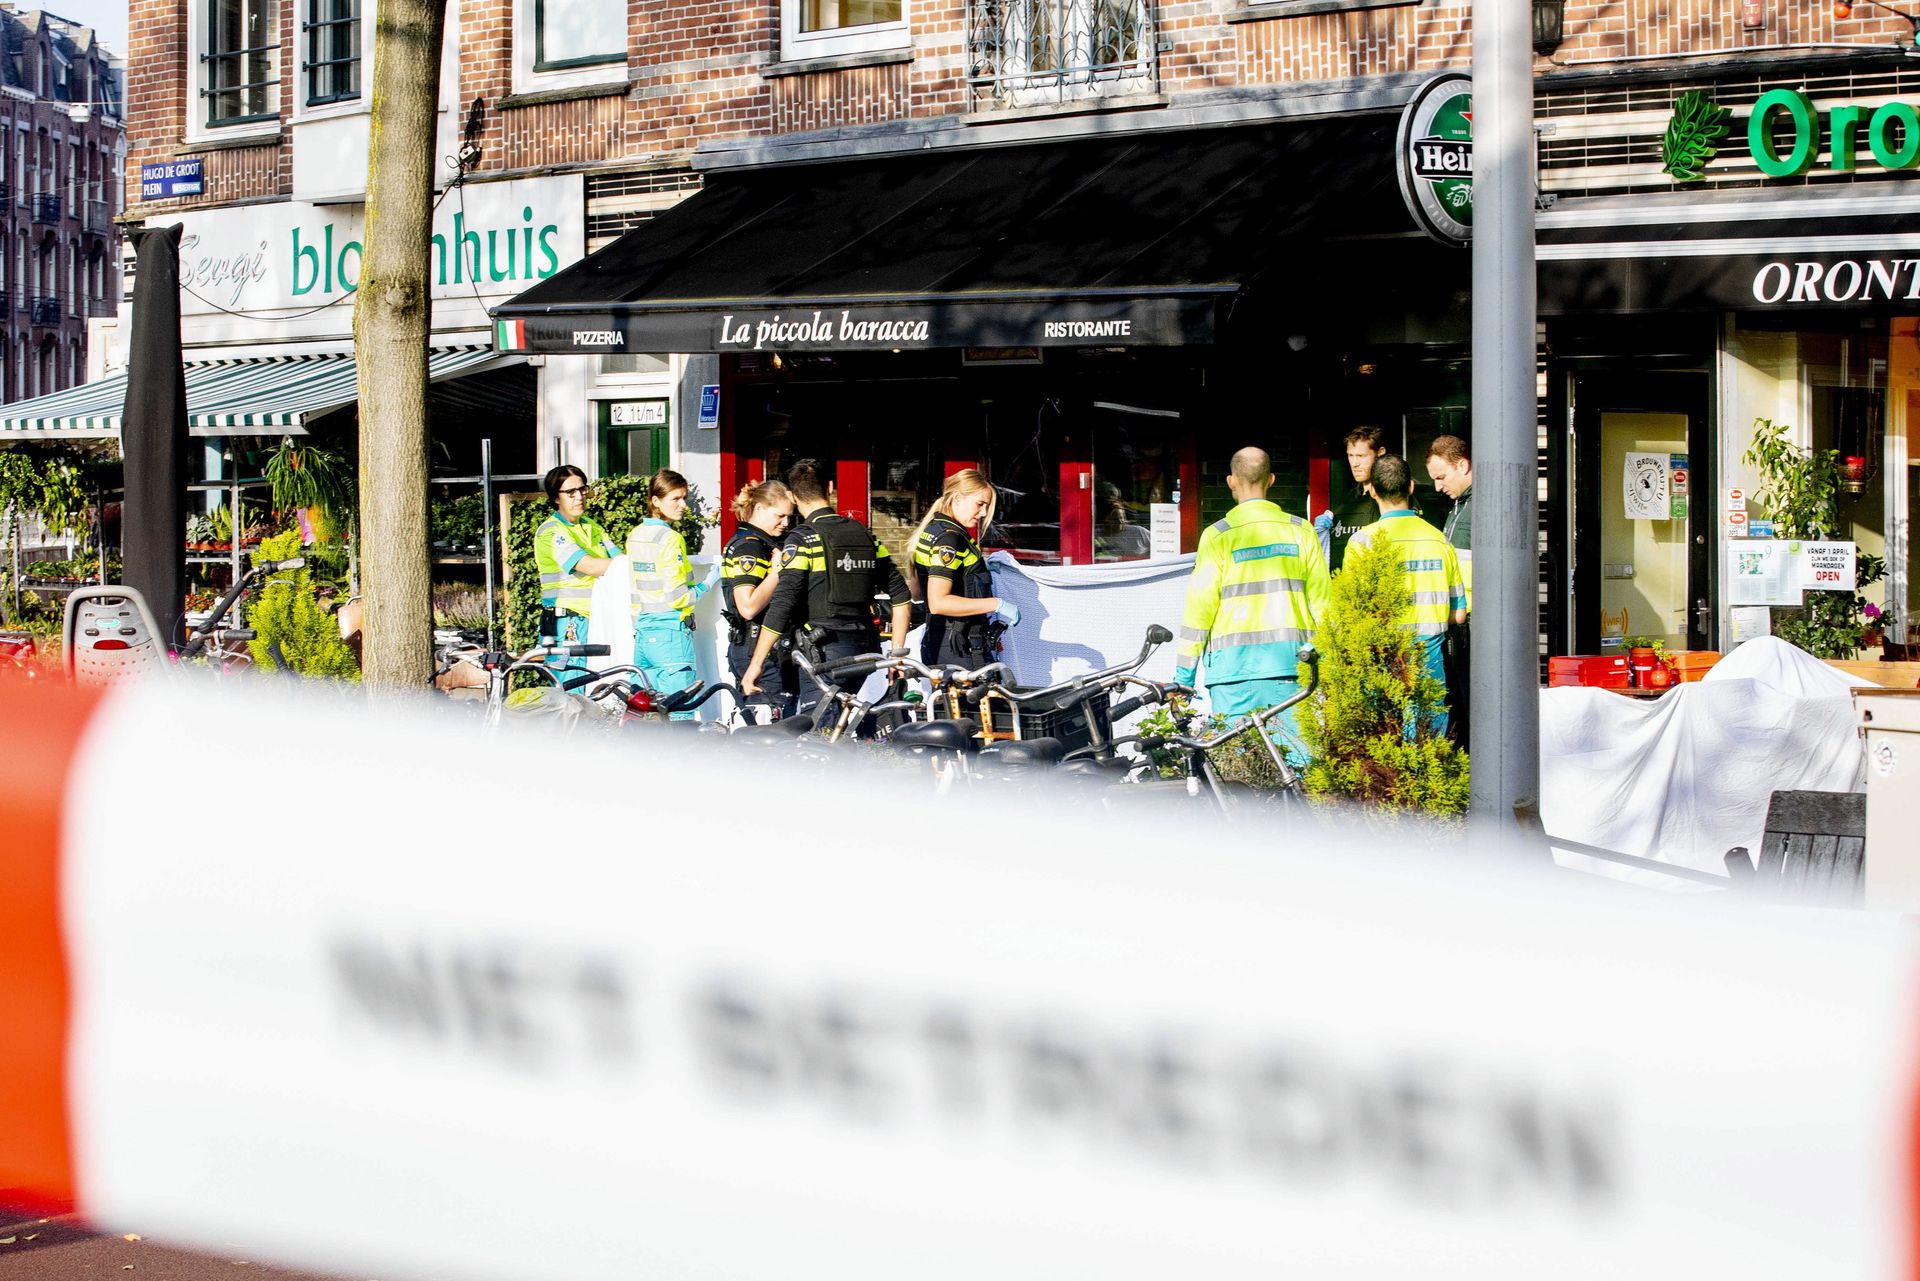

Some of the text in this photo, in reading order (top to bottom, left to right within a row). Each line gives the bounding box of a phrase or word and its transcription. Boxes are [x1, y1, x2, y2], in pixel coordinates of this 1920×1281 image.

[143, 162, 200, 181] HUGO DE GROOT
[143, 182, 162, 196] PLEIN
[720, 310, 929, 350] La piccola baracca
[1044, 320, 1131, 338] RISTORANTE
[573, 331, 624, 346] PIZZERIA
[1234, 545, 1299, 562] AMBULANCE
[1832, 548, 1849, 556] APRIL
[1816, 571, 1840, 581] OPEN
[330, 932, 1628, 1216] NIET BETREDEN
